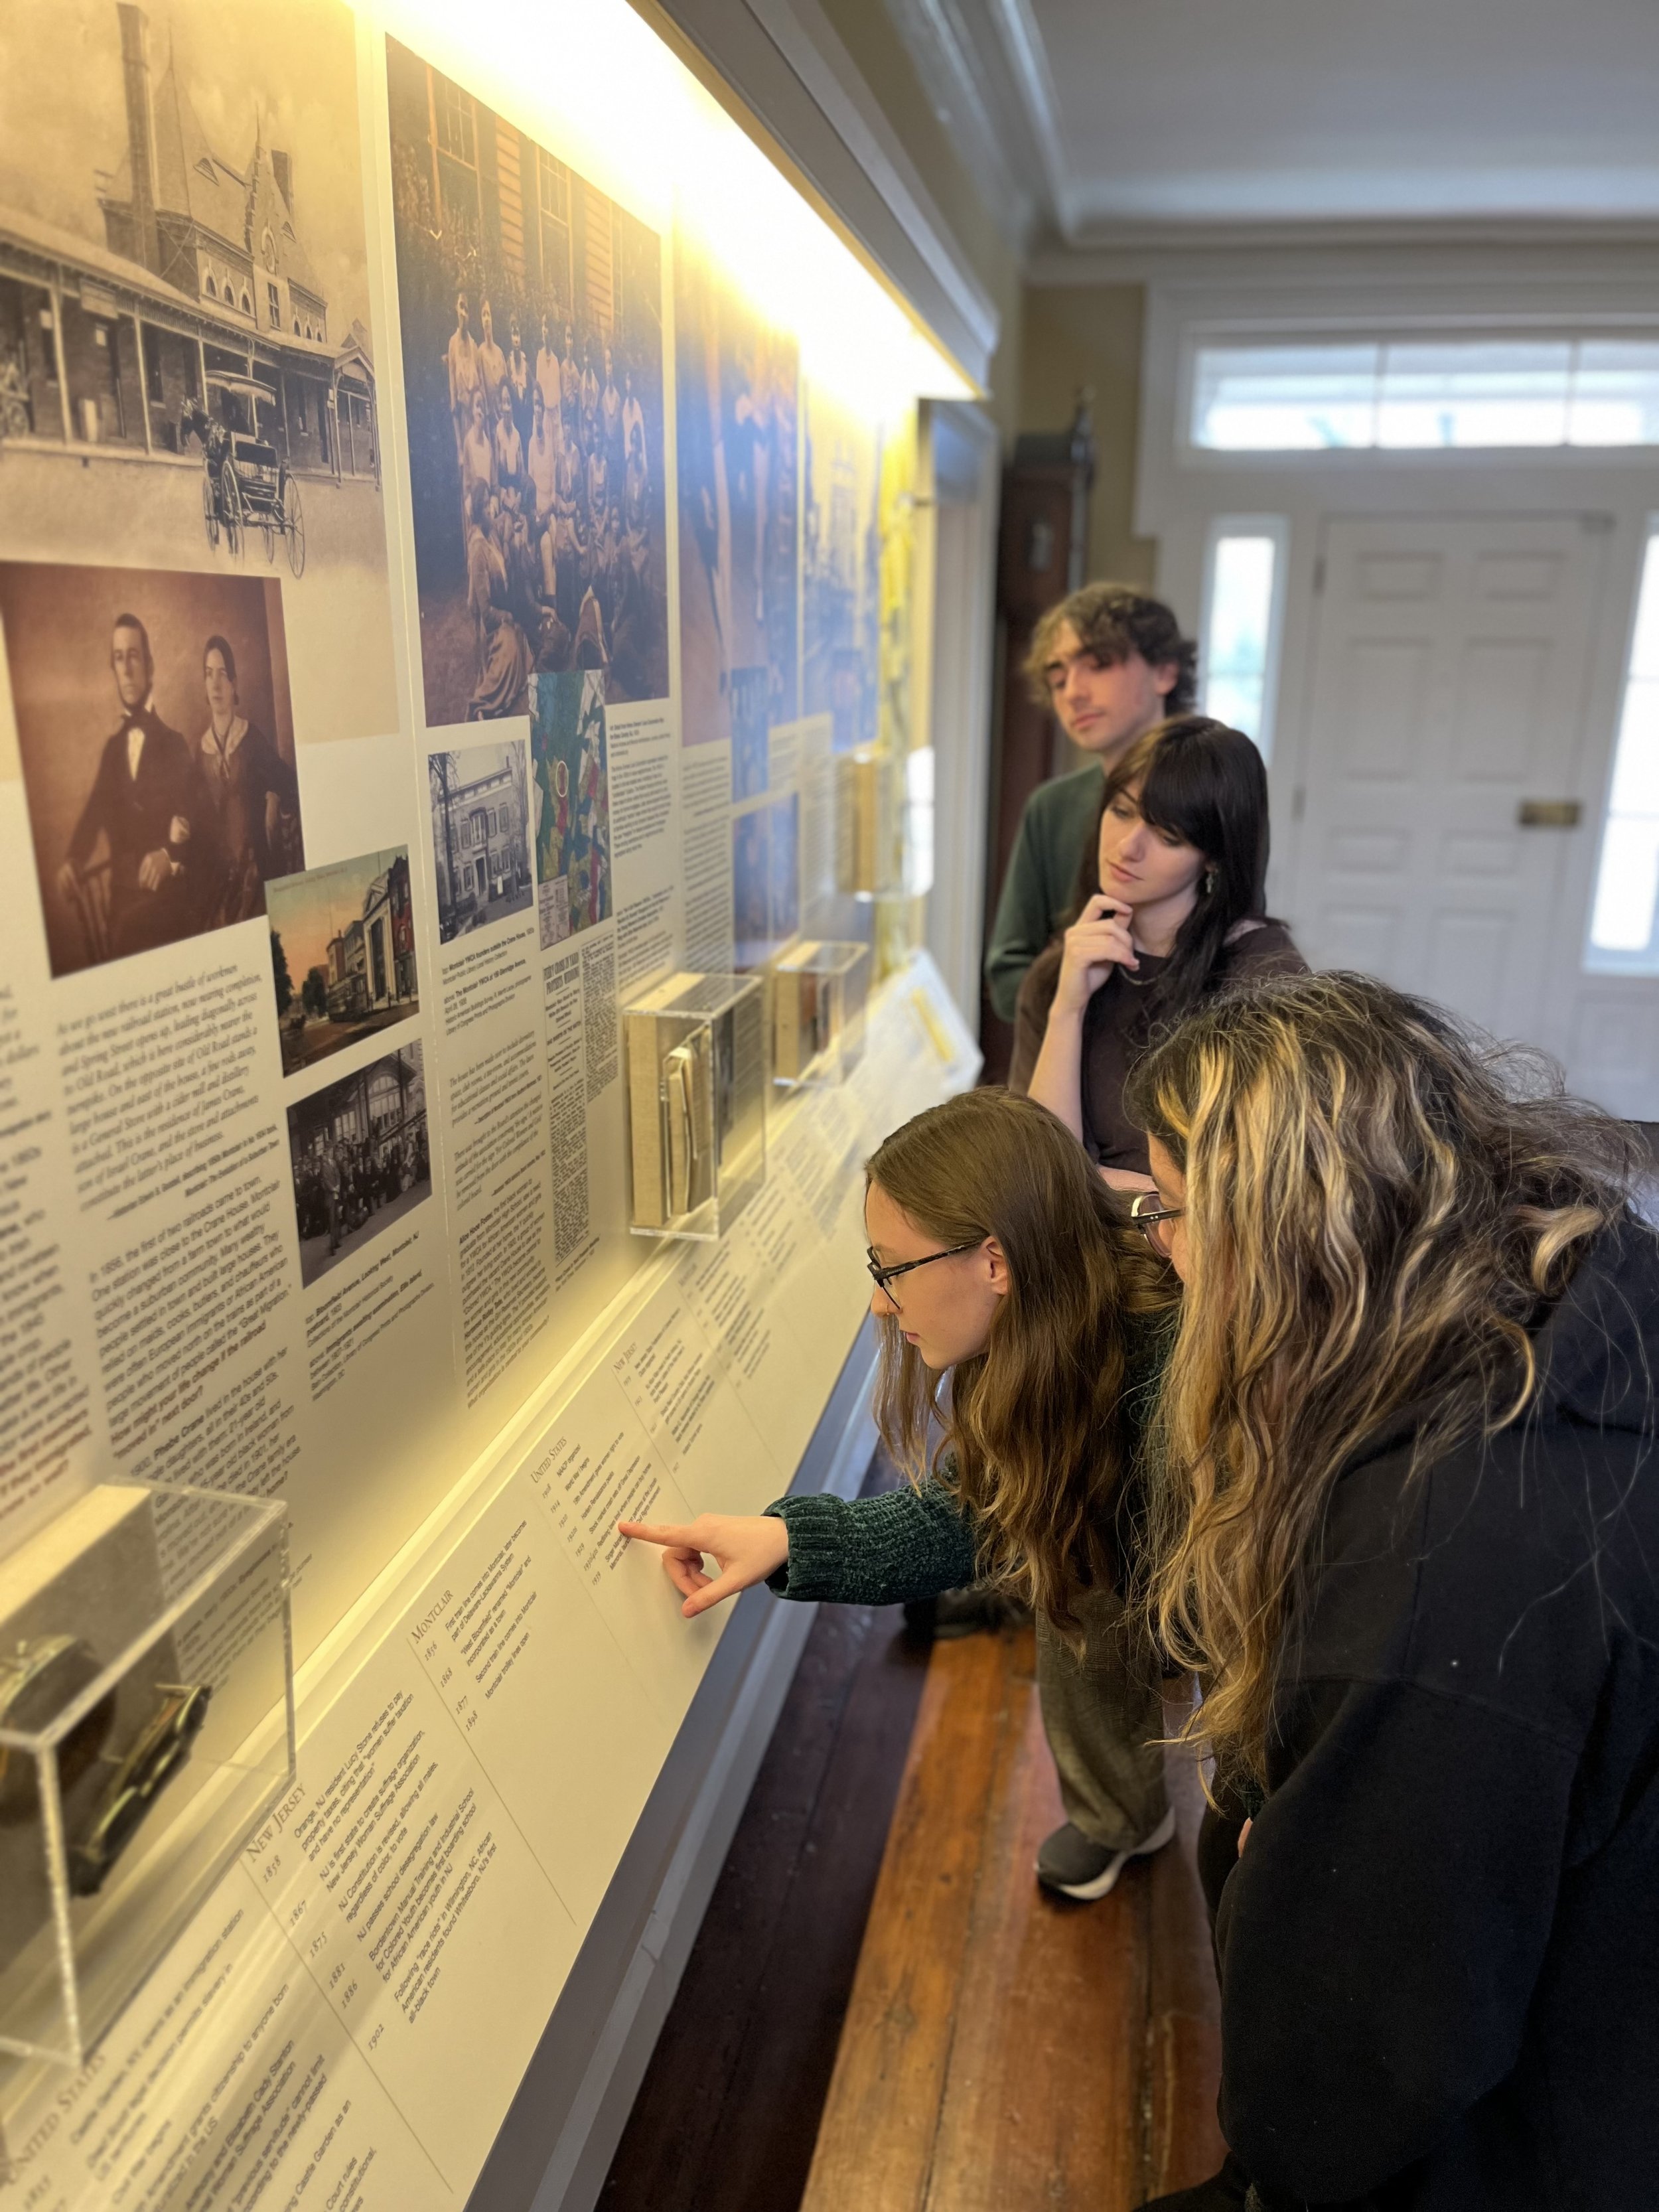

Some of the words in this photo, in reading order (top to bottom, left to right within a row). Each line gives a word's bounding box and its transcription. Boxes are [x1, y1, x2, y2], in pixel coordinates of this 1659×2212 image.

[444, 1616, 456, 1631] First
[453, 1605, 465, 1619] train
[462, 1596, 471, 1608] line
[469, 1580, 483, 1599] comes
[480, 1570, 490, 1582] into
[503, 1538, 512, 1552] later
[510, 1519, 527, 1542] becomes
[451, 1626, 461, 1642] part
[459, 1619, 465, 1630] of
[499, 1552, 514, 1572] System
[491, 1588, 508, 1613] renamed
[523, 1554, 532, 1568] and
[466, 1631, 490, 1667] incorporated
[488, 1625, 494, 1635] as
[495, 1609, 506, 1623] town
[474, 1659, 492, 1683] Second
[488, 1649, 499, 1662] train
[496, 1639, 506, 1651] line
[504, 1622, 517, 1641] comes
[514, 1613, 523, 1625] into
[520, 1591, 537, 1615] Montclair
[484, 1672, 503, 1700] Montclair
[500, 1657, 514, 1675] trolley
[510, 1645, 522, 1659] lines
[519, 1631, 530, 1647] open
[301, 1817, 325, 1852] property
[339, 1775, 356, 1797] citing
[352, 1760, 365, 1777] that
[382, 1716, 396, 1737] suffer
[394, 1693, 413, 1719] taxation
[315, 1794, 326, 1809] NJ
[324, 1767, 346, 1798] resident
[343, 1751, 359, 1770] Lucy
[356, 1732, 373, 1753] Stone
[371, 1709, 389, 1733] refuses
[386, 1702, 394, 1711] to
[392, 1690, 403, 1706] pay
[245, 1826, 273, 1863] NEW
[271, 1782, 305, 1834] JERSEY
[262, 1854, 281, 1883] 1858
[308, 1842, 321, 1862] and
[318, 1825, 334, 1846] have
[332, 1814, 341, 1827] no
[319, 1865, 330, 1881] NJ
[327, 1859, 336, 1869] is
[332, 1842, 346, 1861] first
[344, 1824, 358, 1846] state
[356, 1816, 364, 1827] to
[363, 1794, 380, 1818] create
[378, 1767, 398, 1797] suffrage
[325, 1872, 340, 1892] New
[339, 1846, 358, 1874] Jersey
[354, 1819, 376, 1848] Woman
[374, 1790, 396, 1821] Suffrage
[394, 1753, 420, 1793] Association
[337, 1895, 348, 1911] NJ
[346, 1852, 378, 1899] Constitution
[375, 1844, 383, 1854] is
[399, 1789, 419, 1820] allowing
[289, 1899, 306, 1927] 1867
[345, 1881, 373, 1923] regardless
[371, 1869, 378, 1883] of
[389, 1842, 397, 1853] to
[395, 1826, 407, 1844] vote
[356, 1926, 367, 1942] NJ
[365, 1899, 384, 1931] passes
[382, 1872, 400, 1901] school
[398, 1825, 431, 1876] desegregation
[428, 1812, 438, 1827] law
[368, 1912, 400, 1962] Bordentown
[396, 1882, 417, 1914] Manual
[413, 1856, 435, 1885] Training
[431, 1840, 442, 1858] and
[439, 1809, 461, 1844] Industrial
[457, 1787, 474, 1813] School
[375, 1956, 385, 1972] for
[382, 1924, 404, 1959] Colored
[401, 1903, 417, 1927] Youth
[414, 1870, 437, 1906] becomes
[434, 1854, 446, 1872] first
[443, 1825, 465, 1858] boarding
[461, 1802, 476, 1828] school
[394, 1961, 419, 2002] Following
[439, 1910, 447, 1921] in
[476, 1831, 492, 1857] African
[309, 1931, 326, 1958] 1875
[382, 1968, 392, 1982] for
[390, 1940, 409, 1971] African
[406, 1904, 429, 1943] American
[427, 1883, 442, 1908] youth
[439, 1875, 447, 1885] in
[443, 1862, 453, 1877] NJ
[401, 1972, 425, 2014] American
[423, 1937, 445, 1974] residents
[441, 1913, 457, 1939] found
[477, 1856, 489, 1874] NJ's
[486, 1842, 497, 1858] first
[328, 1962, 345, 1989] 1881
[341, 1978, 358, 2009] 1886
[408, 1986, 429, 2024] all-black
[426, 1966, 441, 1988] town
[367, 2023, 384, 2051] 1902
